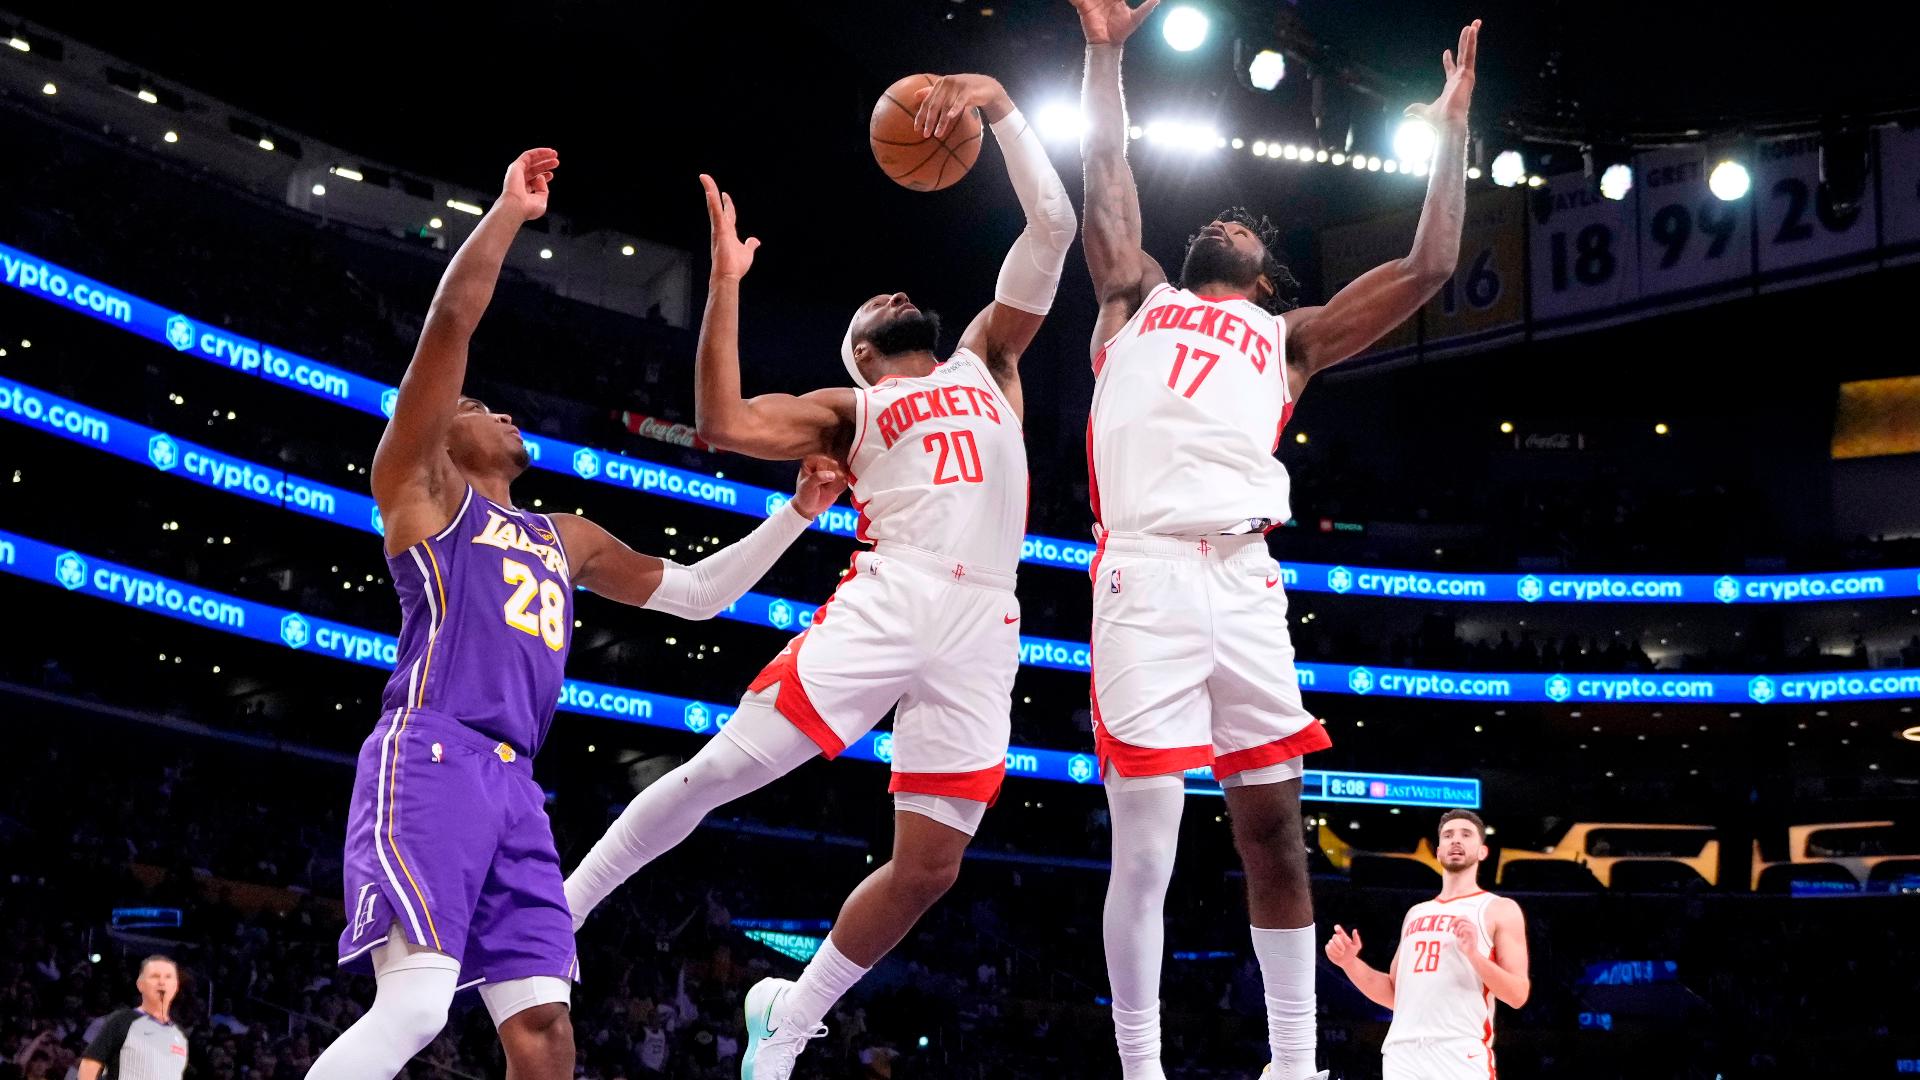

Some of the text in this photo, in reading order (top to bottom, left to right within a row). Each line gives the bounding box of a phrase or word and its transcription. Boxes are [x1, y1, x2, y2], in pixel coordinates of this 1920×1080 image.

[1552, 224, 1616, 291] 18
[0, 252, 132, 323] ypto.com
[1138, 304, 1272, 375] ROCKETS
[200, 332, 350, 398] crypto.com
[1167, 343, 1220, 399] 17
[876, 384, 1001, 450] ROCKETS
[922, 430, 984, 485] 20
[183, 450, 335, 515] crypto.com
[605, 458, 737, 506] crypto.com
[93, 568, 245, 628] crypto.com
[502, 557, 566, 652] 28
[1358, 571, 1486, 598] crypto.com
[1548, 576, 1683, 601] crypto.com
[1745, 574, 1885, 600] crypto.com
[315, 625, 398, 665] crypto
[1379, 674, 1511, 699] crypto.com
[1577, 677, 1714, 702] crypto.com
[1781, 675, 1920, 701] crypto.com
[1331, 779, 1366, 796] 8:08
[1404, 914, 1458, 939] ROCKET
[1413, 941, 1441, 973] 28
